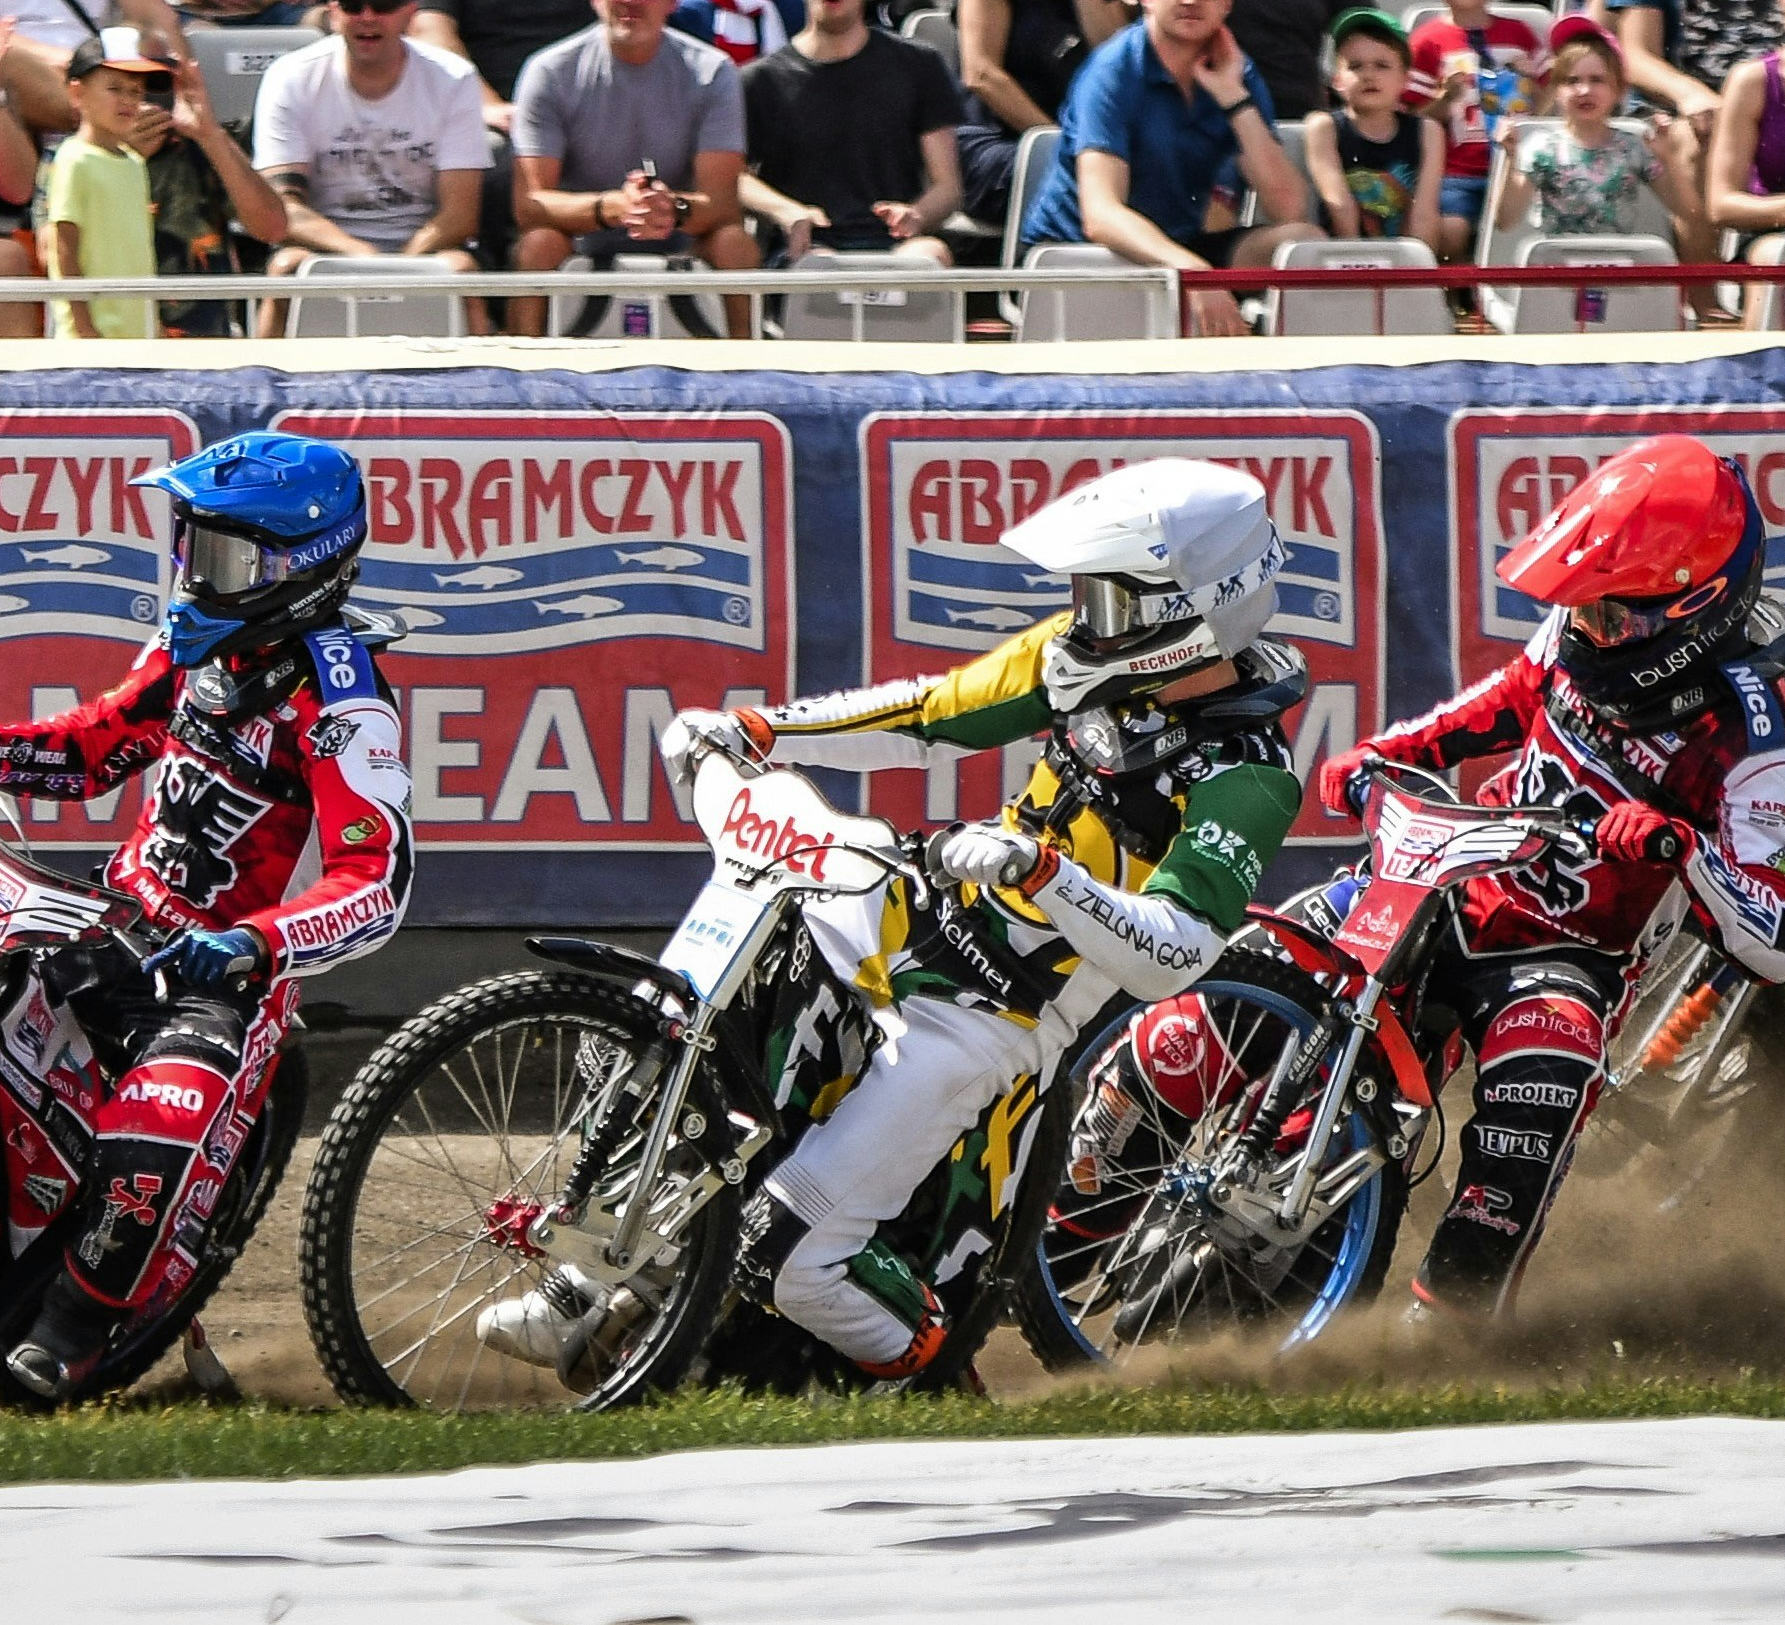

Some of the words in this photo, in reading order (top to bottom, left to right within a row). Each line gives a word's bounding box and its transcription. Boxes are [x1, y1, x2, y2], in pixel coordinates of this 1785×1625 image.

[366, 458, 747, 560] BRAMCZYK
[287, 524, 358, 569] OKULARY
[315, 629, 357, 690] Nice
[1129, 642, 1205, 673] BECKHOFF
[1727, 663, 1772, 738] Nice
[287, 885, 396, 950] ABRAMCZYK
[1074, 887, 1154, 960] ZIELONA
[1162, 1023, 1190, 1055] DUAL
[1495, 1083, 1578, 1109] PROJEKT
